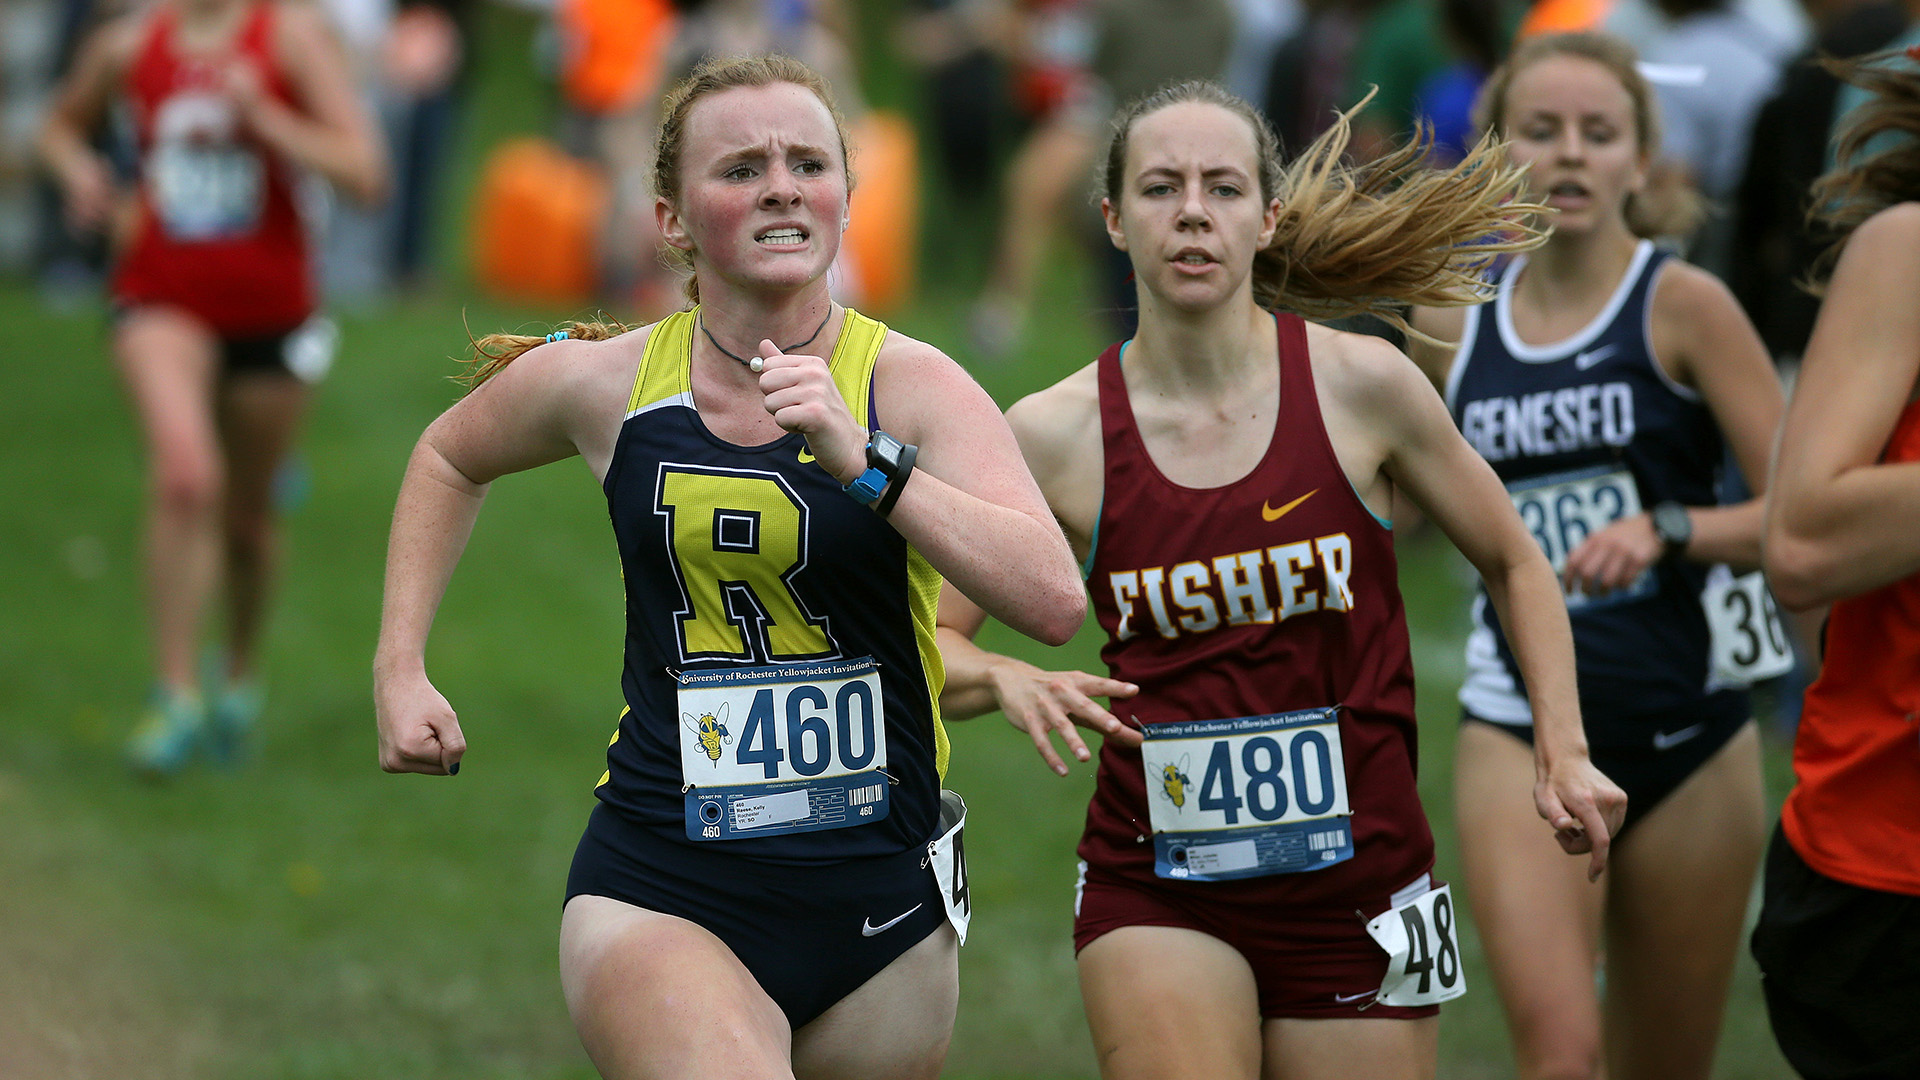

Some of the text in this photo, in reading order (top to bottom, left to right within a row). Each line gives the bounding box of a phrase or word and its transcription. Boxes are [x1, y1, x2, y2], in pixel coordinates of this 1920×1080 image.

[1461, 380, 1636, 463] GENESEO
[653, 461, 844, 664] R
[1108, 531, 1355, 642] FISHER
[725, 672, 735, 681] of
[736, 670, 777, 681] Rochester
[778, 666, 831, 678] Yellowjacket
[736, 679, 876, 780] 460
[1184, 724, 1193, 733] of
[1194, 722, 1232, 733] Rochester
[1232, 717, 1285, 729] Yellowjacket
[859, 805, 873, 817] 460
[1198, 730, 1336, 825] 480
[702, 826, 721, 838] 460
[951, 826, 970, 918] 4
[1399, 892, 1458, 994] 48
